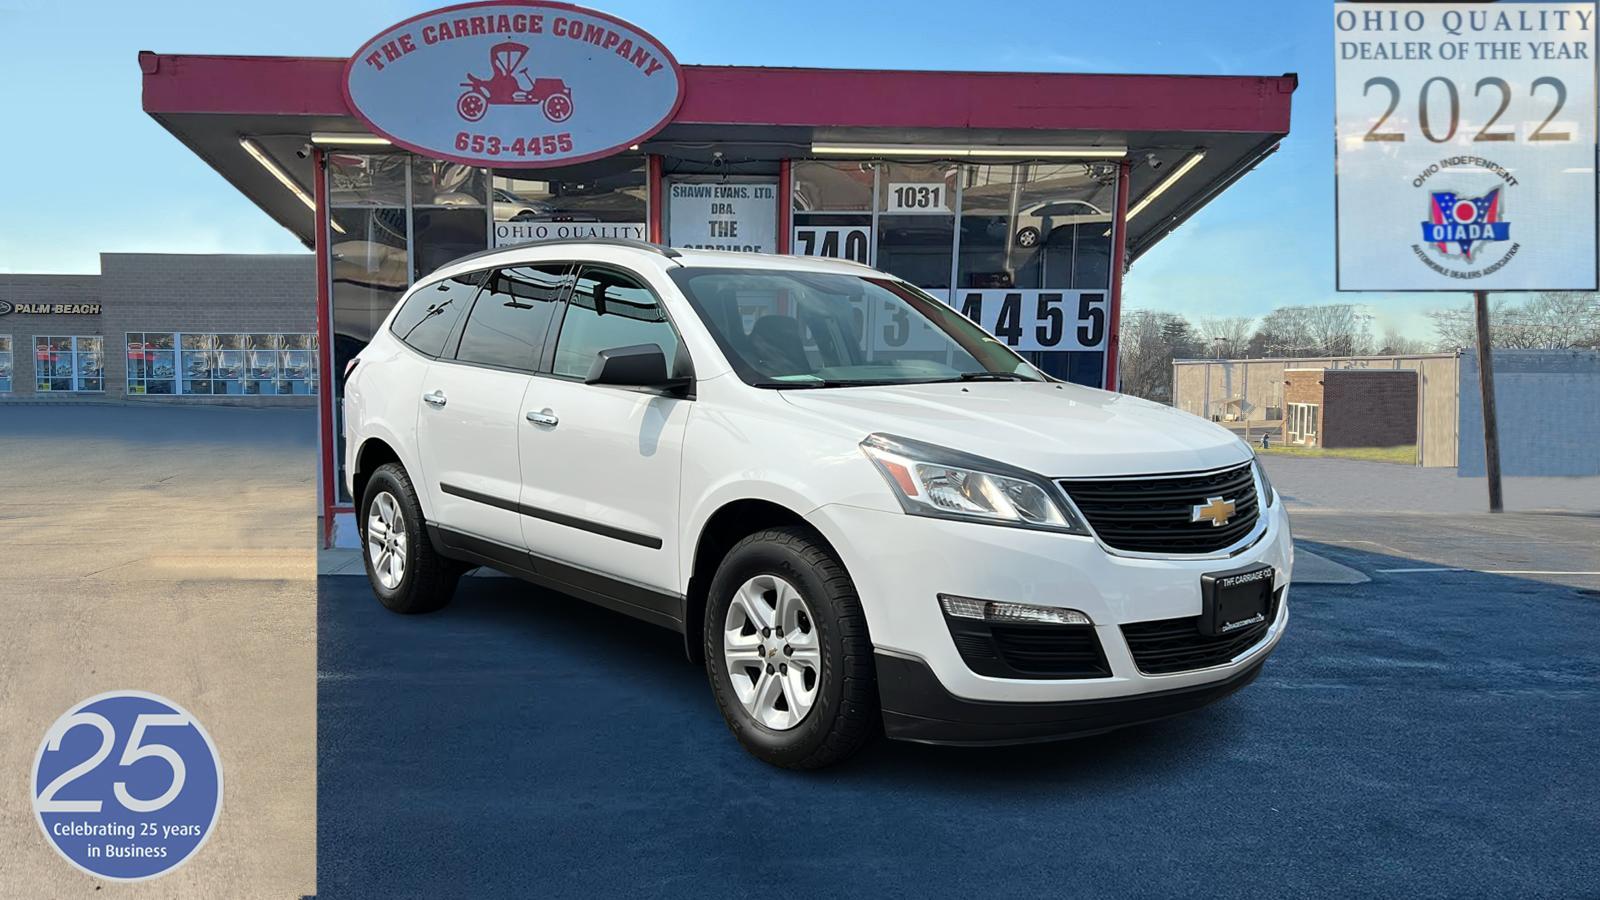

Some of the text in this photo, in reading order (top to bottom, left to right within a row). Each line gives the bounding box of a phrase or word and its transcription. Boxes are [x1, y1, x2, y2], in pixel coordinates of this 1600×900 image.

[1336, 10, 1592, 36] OHIO QUALITY
[365, 15, 663, 77] THE CARRIAGE COMPANY
[1340, 42, 1589, 60] DEALER OF THE YEAR
[1362, 76, 1571, 143] 2022
[455, 132, 573, 157] 653-4455
[1412, 155, 1519, 188] OHIO INDEPENDENT
[673, 186, 712, 198] SHAWN
[754, 188, 775, 199] LTD.
[894, 186, 940, 208] 1031
[711, 203, 736, 215] DBA.
[497, 225, 644, 240] OHIO QUALITY
[708, 220, 738, 237] THE
[1432, 224, 1495, 241] OIADA
[797, 230, 868, 265] 740
[1411, 242, 1520, 280] AUTOMOBILE DEALERS ASSOCIATION
[14, 303, 101, 314] PALM BEACH
